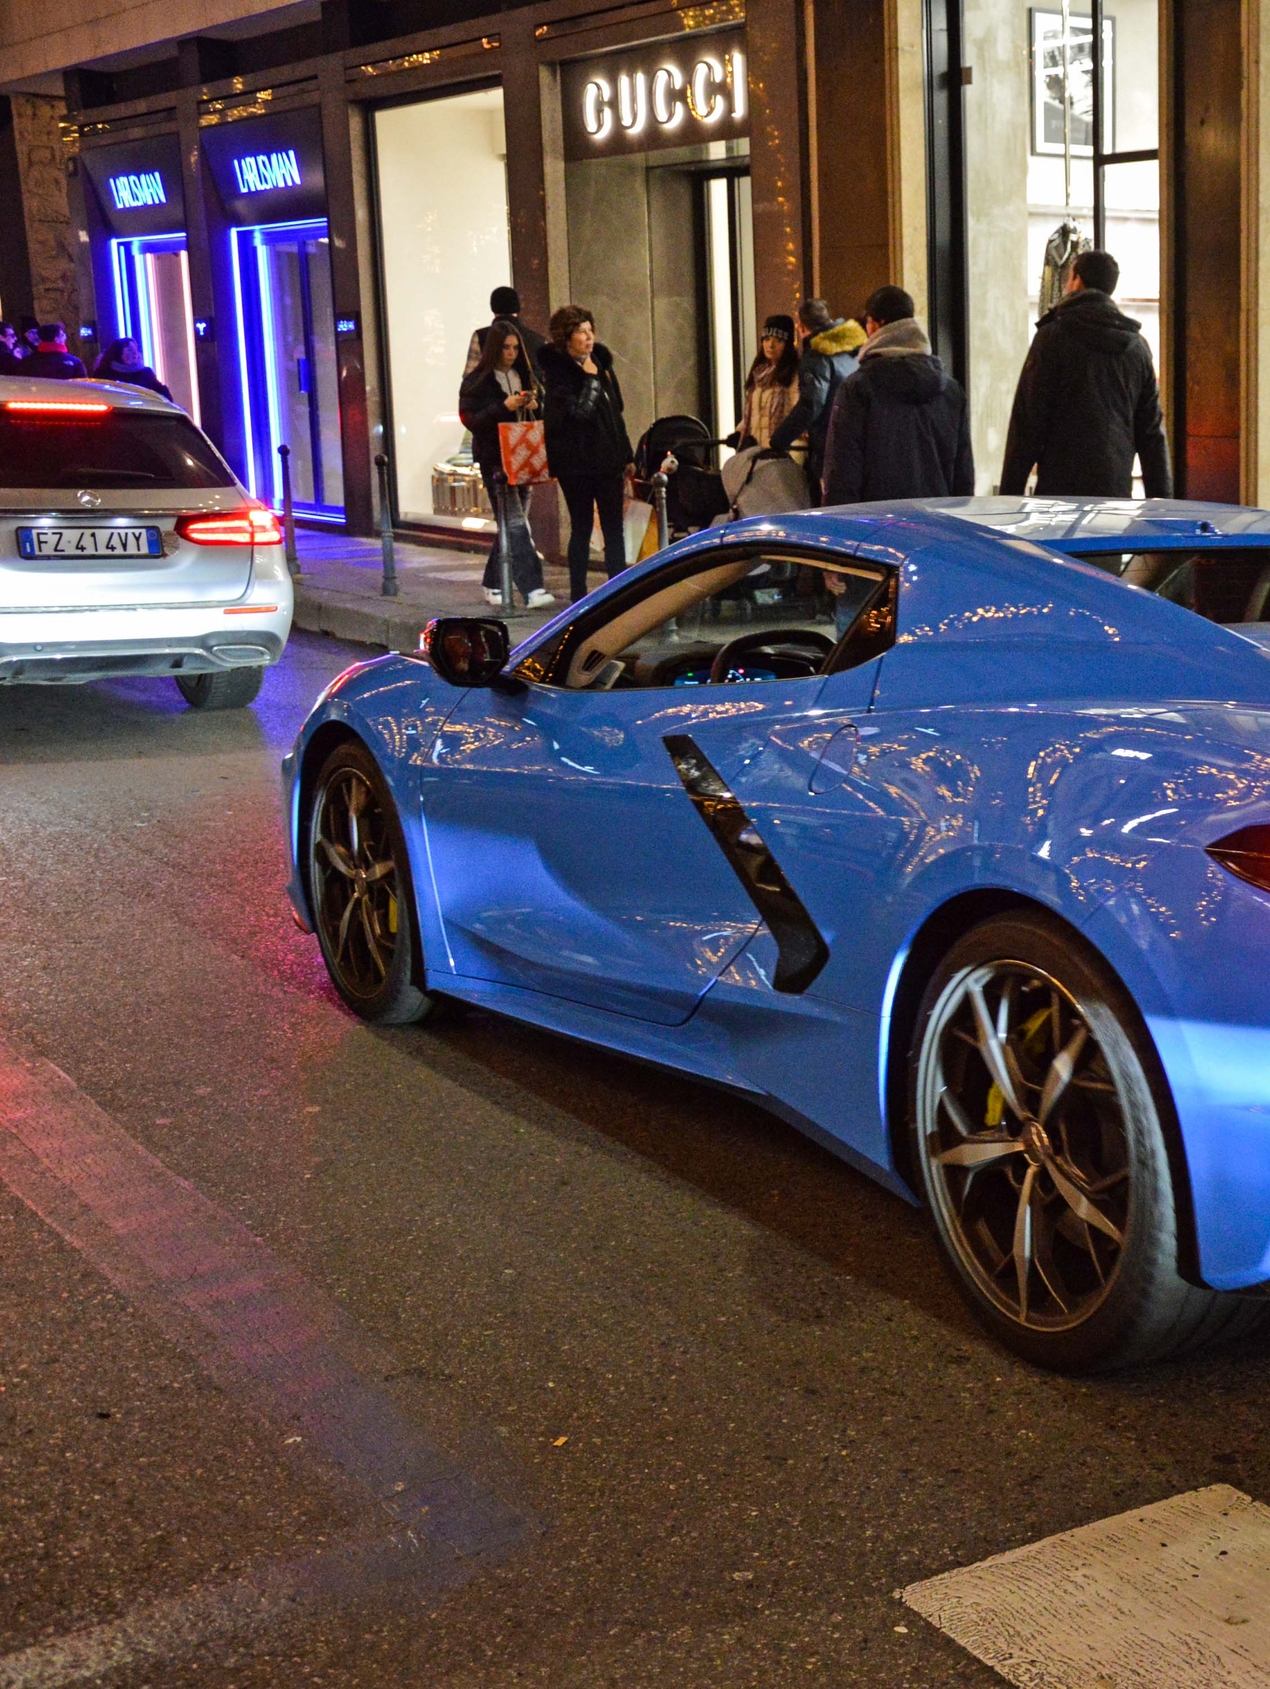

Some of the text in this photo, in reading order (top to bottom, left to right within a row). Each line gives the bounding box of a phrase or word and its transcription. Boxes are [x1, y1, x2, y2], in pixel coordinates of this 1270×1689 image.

[584, 52, 744, 139] GUCCI
[36, 532, 65, 552] FZ
[75, 532, 142, 552] 414VY
